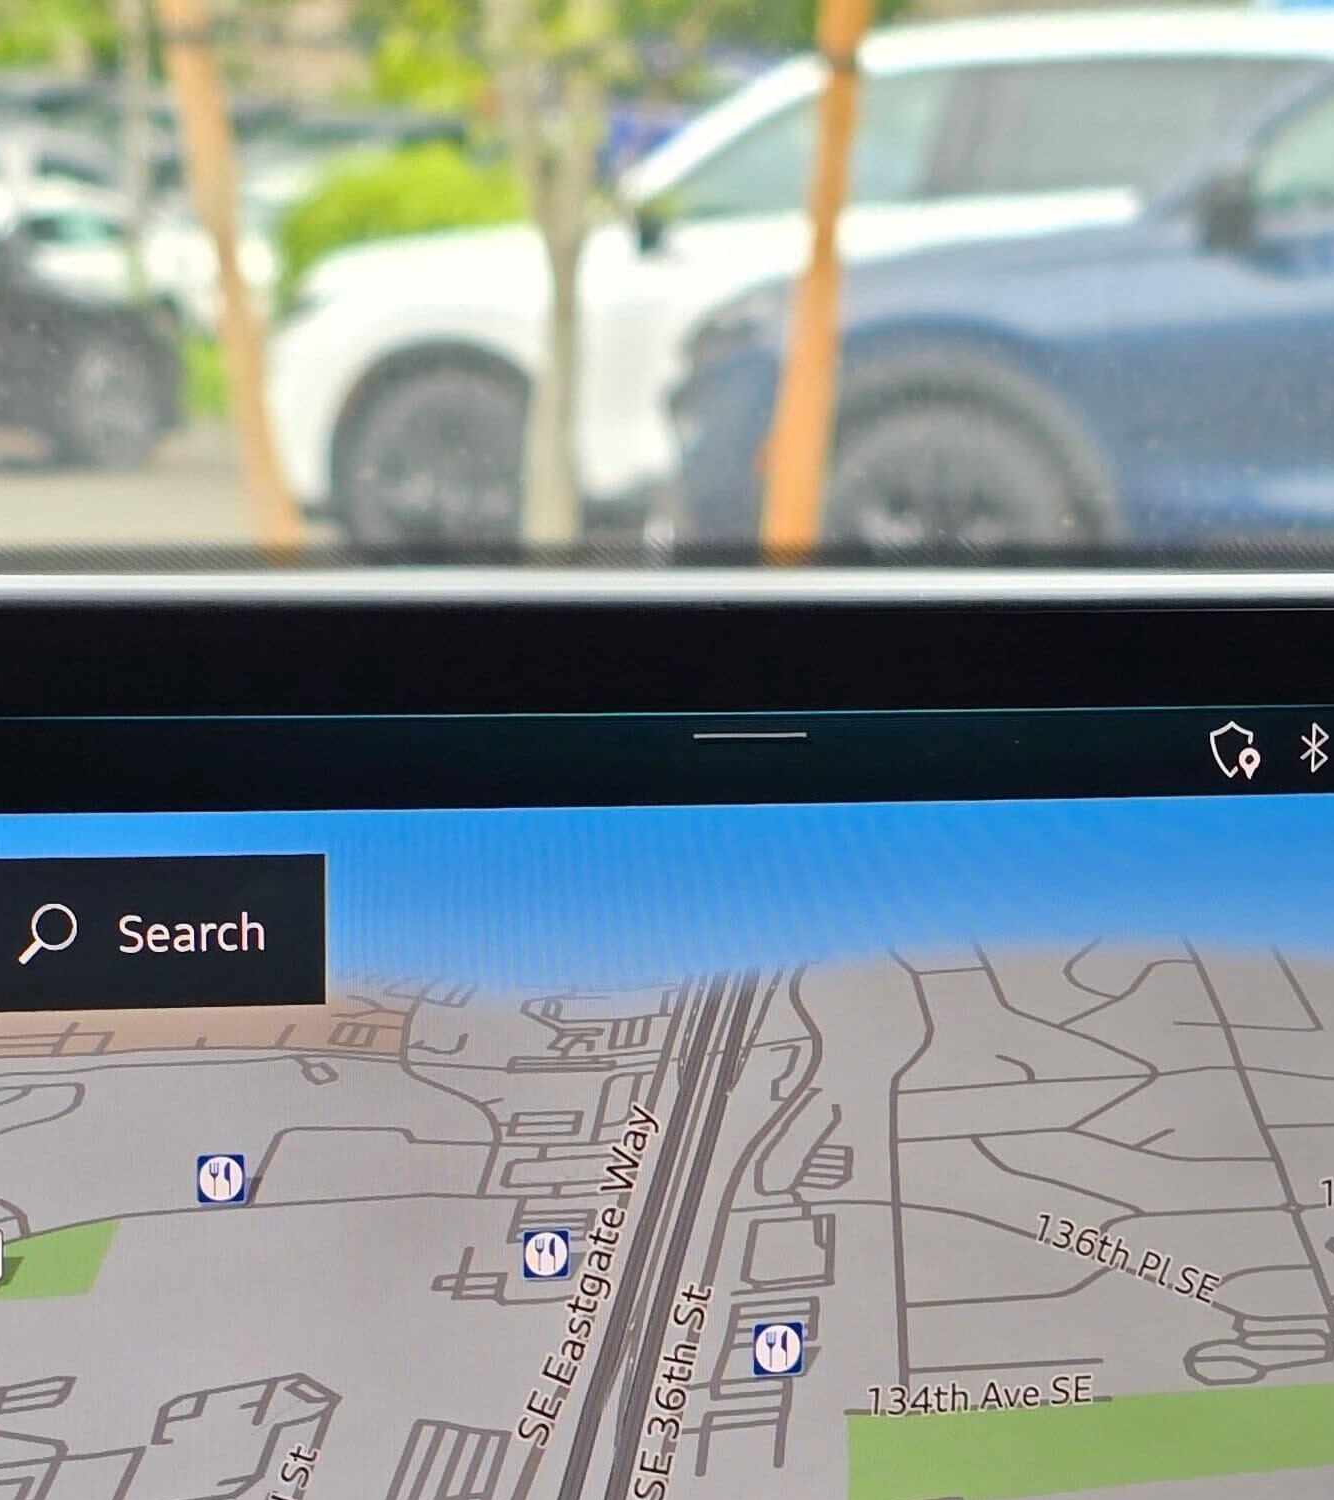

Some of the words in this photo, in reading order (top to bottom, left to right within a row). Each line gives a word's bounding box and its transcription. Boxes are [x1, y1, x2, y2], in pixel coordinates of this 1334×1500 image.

[118, 910, 266, 954] Search
[517, 1389, 563, 1447] SE
[541, 1206, 626, 1387] Eastgate
[599, 1103, 660, 1192] Way
[1038, 1213, 1130, 1271] 136th
[1137, 1250, 1172, 1287] Pl
[1174, 1266, 1221, 1304] SE
[646, 1342, 698, 1440] 36th
[673, 1283, 712, 1331] St
[868, 1382, 969, 1416] 134th
[979, 1381, 1040, 1410] Ave
[1051, 1374, 1093, 1405] SE
[280, 1445, 318, 1489] St
